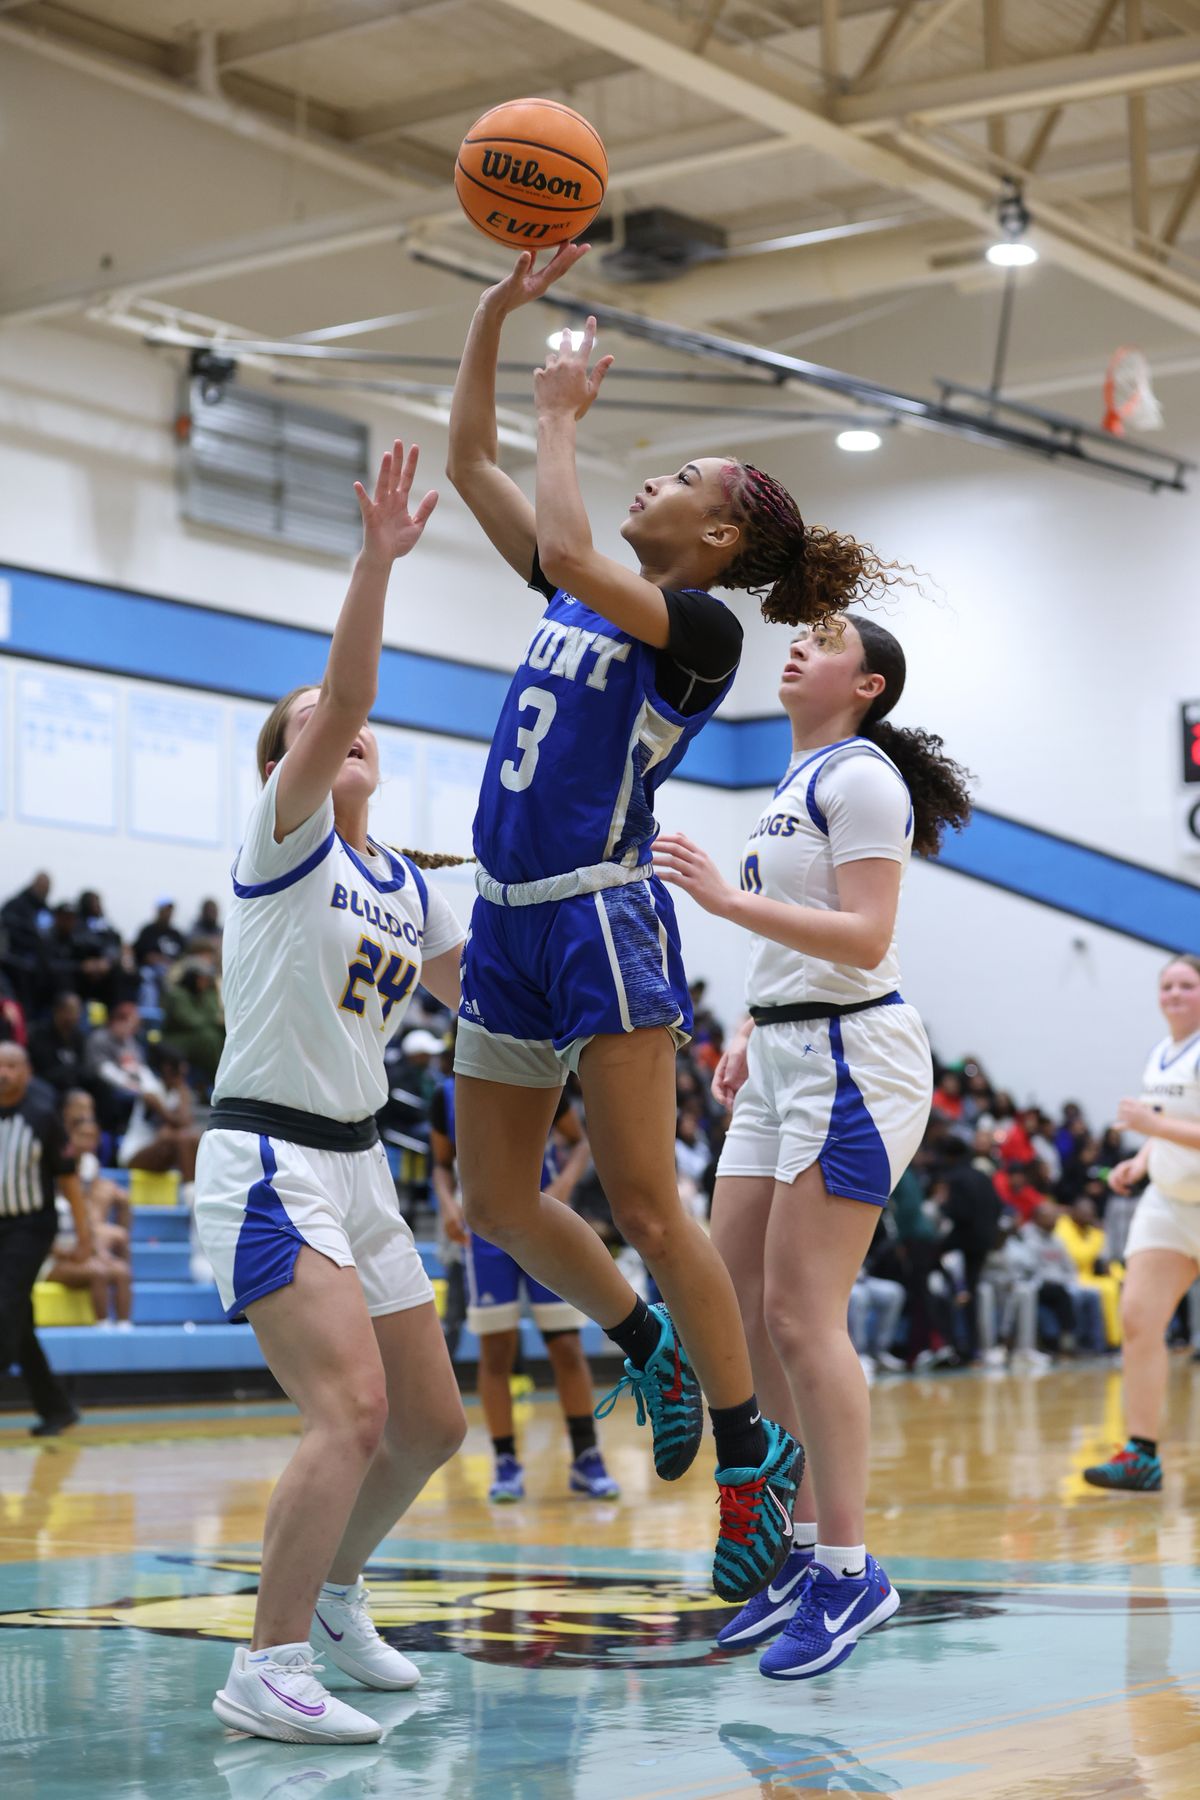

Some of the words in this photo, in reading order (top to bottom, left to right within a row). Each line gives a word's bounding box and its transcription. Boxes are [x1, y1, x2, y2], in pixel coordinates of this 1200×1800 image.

[482, 149, 582, 201] Wilson
[486, 210, 550, 238] EVO
[500, 686, 557, 792] 3
[338, 933, 418, 1032] 24
